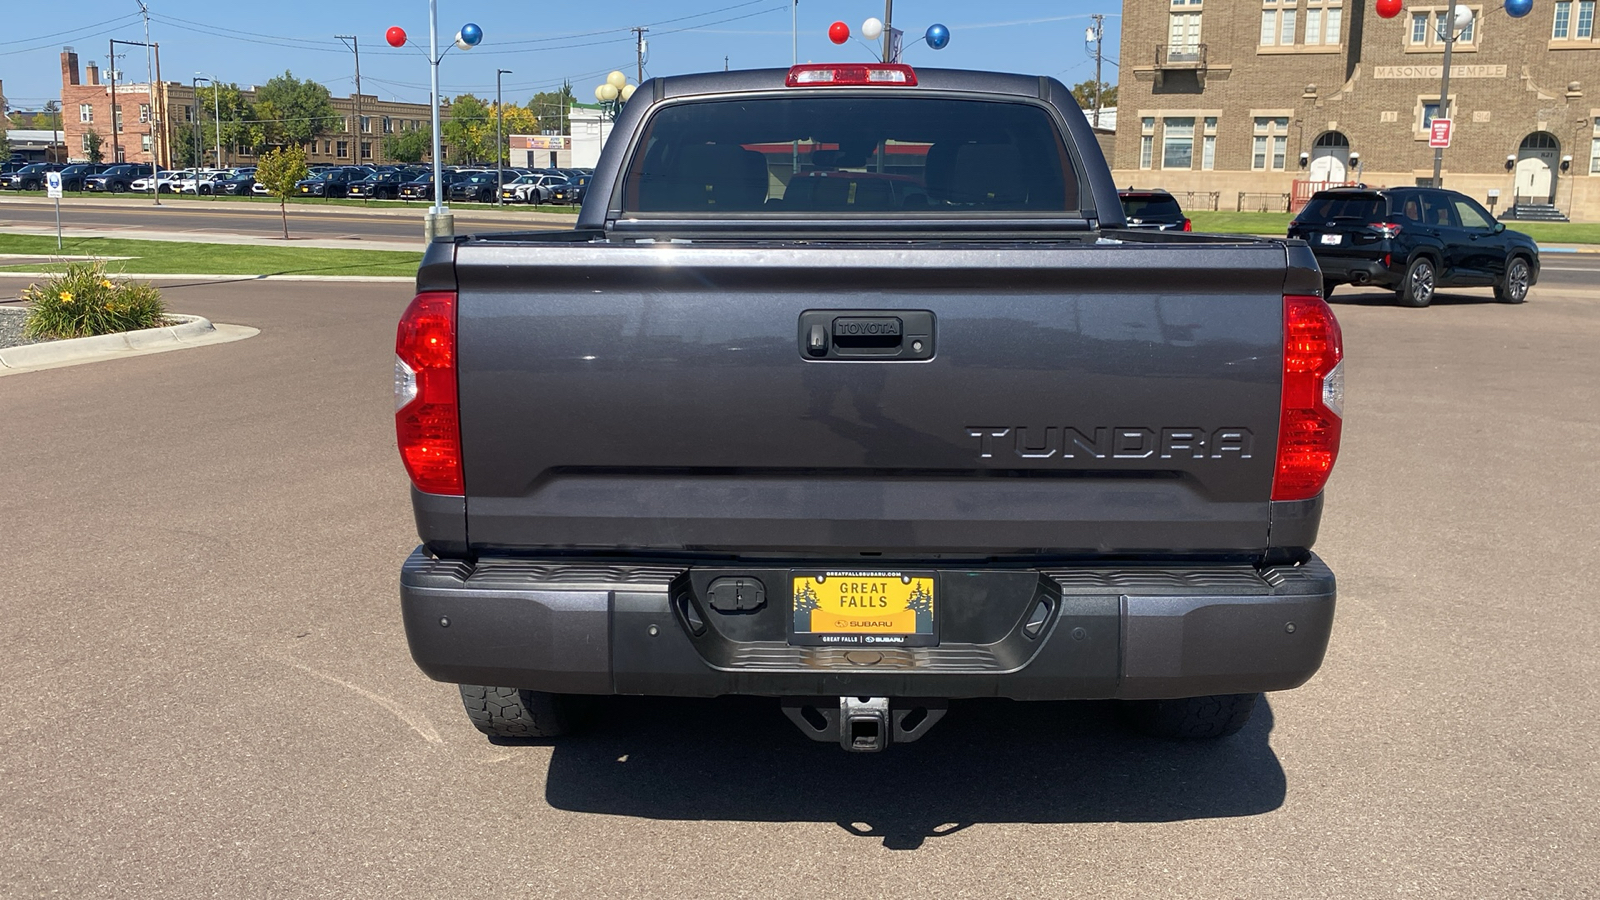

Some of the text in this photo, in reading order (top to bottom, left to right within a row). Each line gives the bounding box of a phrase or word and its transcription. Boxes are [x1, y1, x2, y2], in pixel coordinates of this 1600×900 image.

[1376, 66, 1504, 77] MASONIC TEMPLE
[838, 322, 898, 335] TOYOTA
[965, 426, 1253, 458] TUNDRA
[840, 582, 888, 594] GREAT
[840, 595, 888, 608] FALLS
